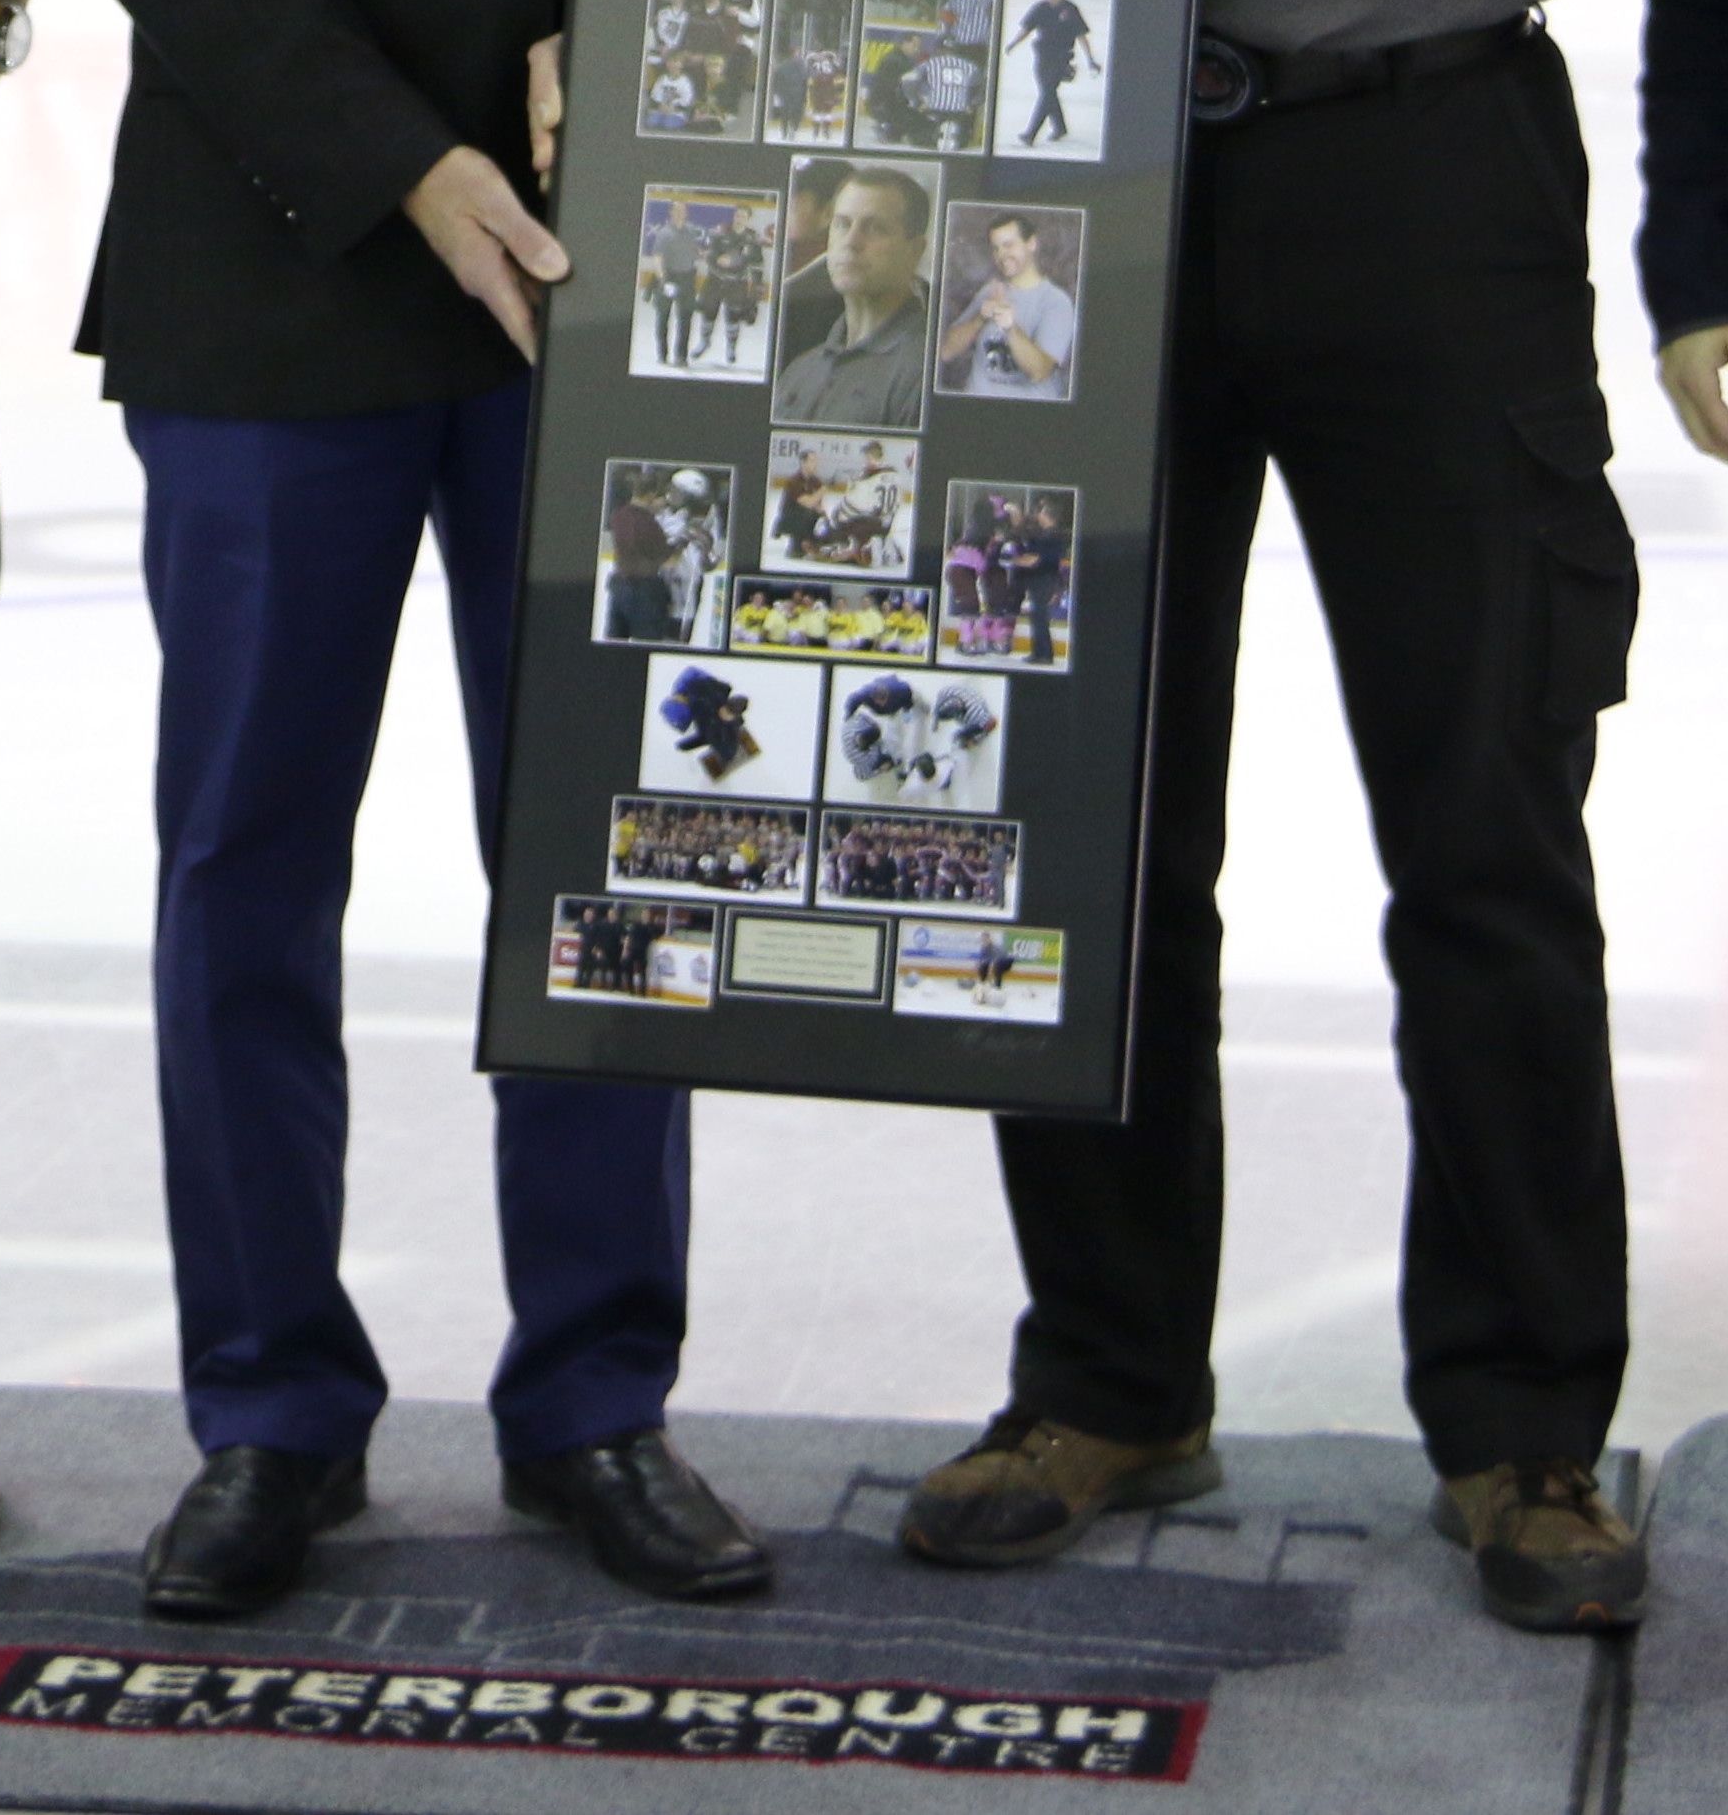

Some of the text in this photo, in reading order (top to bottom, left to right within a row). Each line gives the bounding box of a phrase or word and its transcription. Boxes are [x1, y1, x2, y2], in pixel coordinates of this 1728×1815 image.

[9, 1685, 1137, 1774] MEMORIAL CENTRE
[35, 1654, 1149, 1742] PETERBOROUGH
